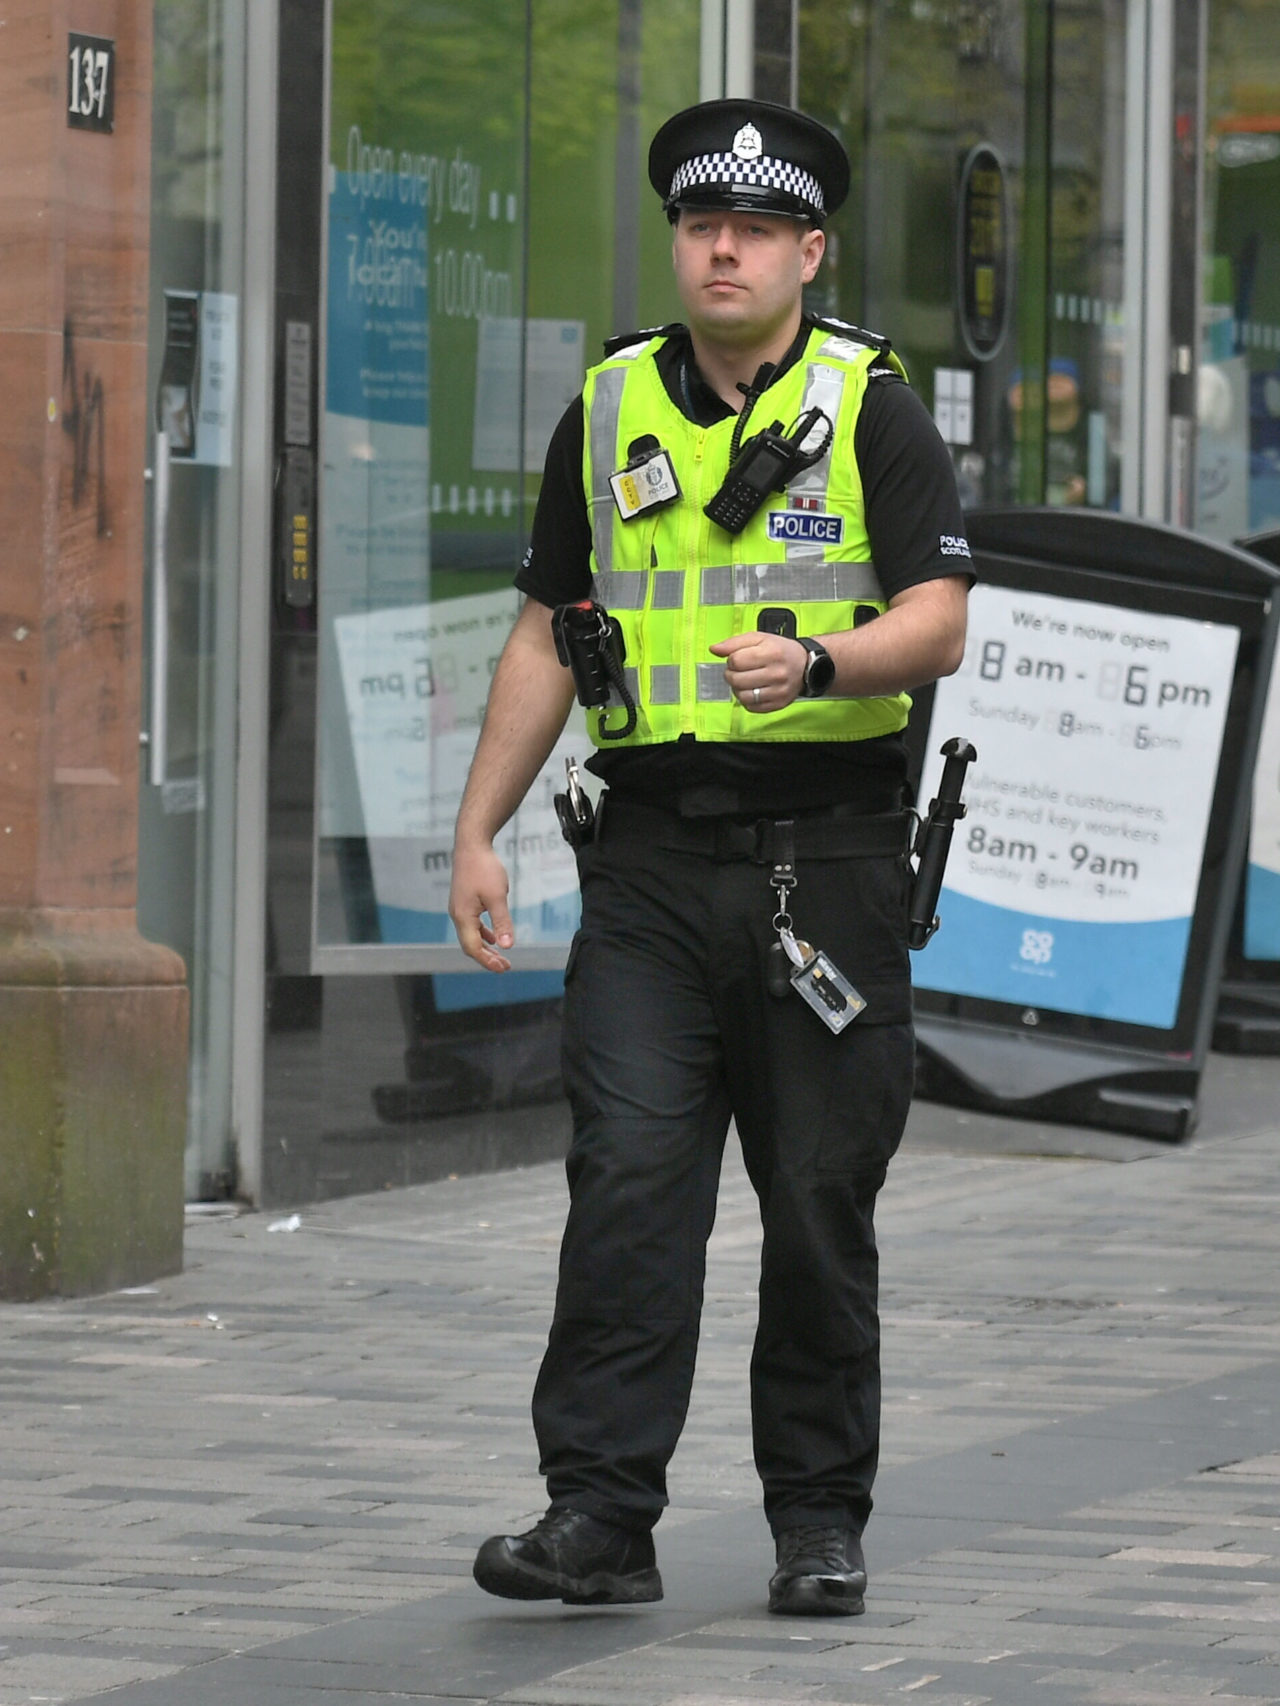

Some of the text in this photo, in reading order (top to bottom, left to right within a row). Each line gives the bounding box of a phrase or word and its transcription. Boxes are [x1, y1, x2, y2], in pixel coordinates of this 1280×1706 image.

[69, 46, 109, 118] 137
[347, 124, 482, 230] Open every day
[647, 481, 670, 496] POLICE
[773, 516, 838, 540] POLICE
[1011, 608, 1170, 653] We're now open
[980, 640, 1006, 682] 8
[1015, 655, 1065, 682] am
[1124, 664, 1149, 707] 6
[1158, 680, 1212, 708] pm
[968, 700, 1041, 731] Sunday
[1006, 802, 1043, 825] and
[1048, 806, 1081, 834] key
[1085, 817, 1161, 845] workers
[966, 826, 1037, 864] 8am
[1070, 843, 1139, 882] 9am
